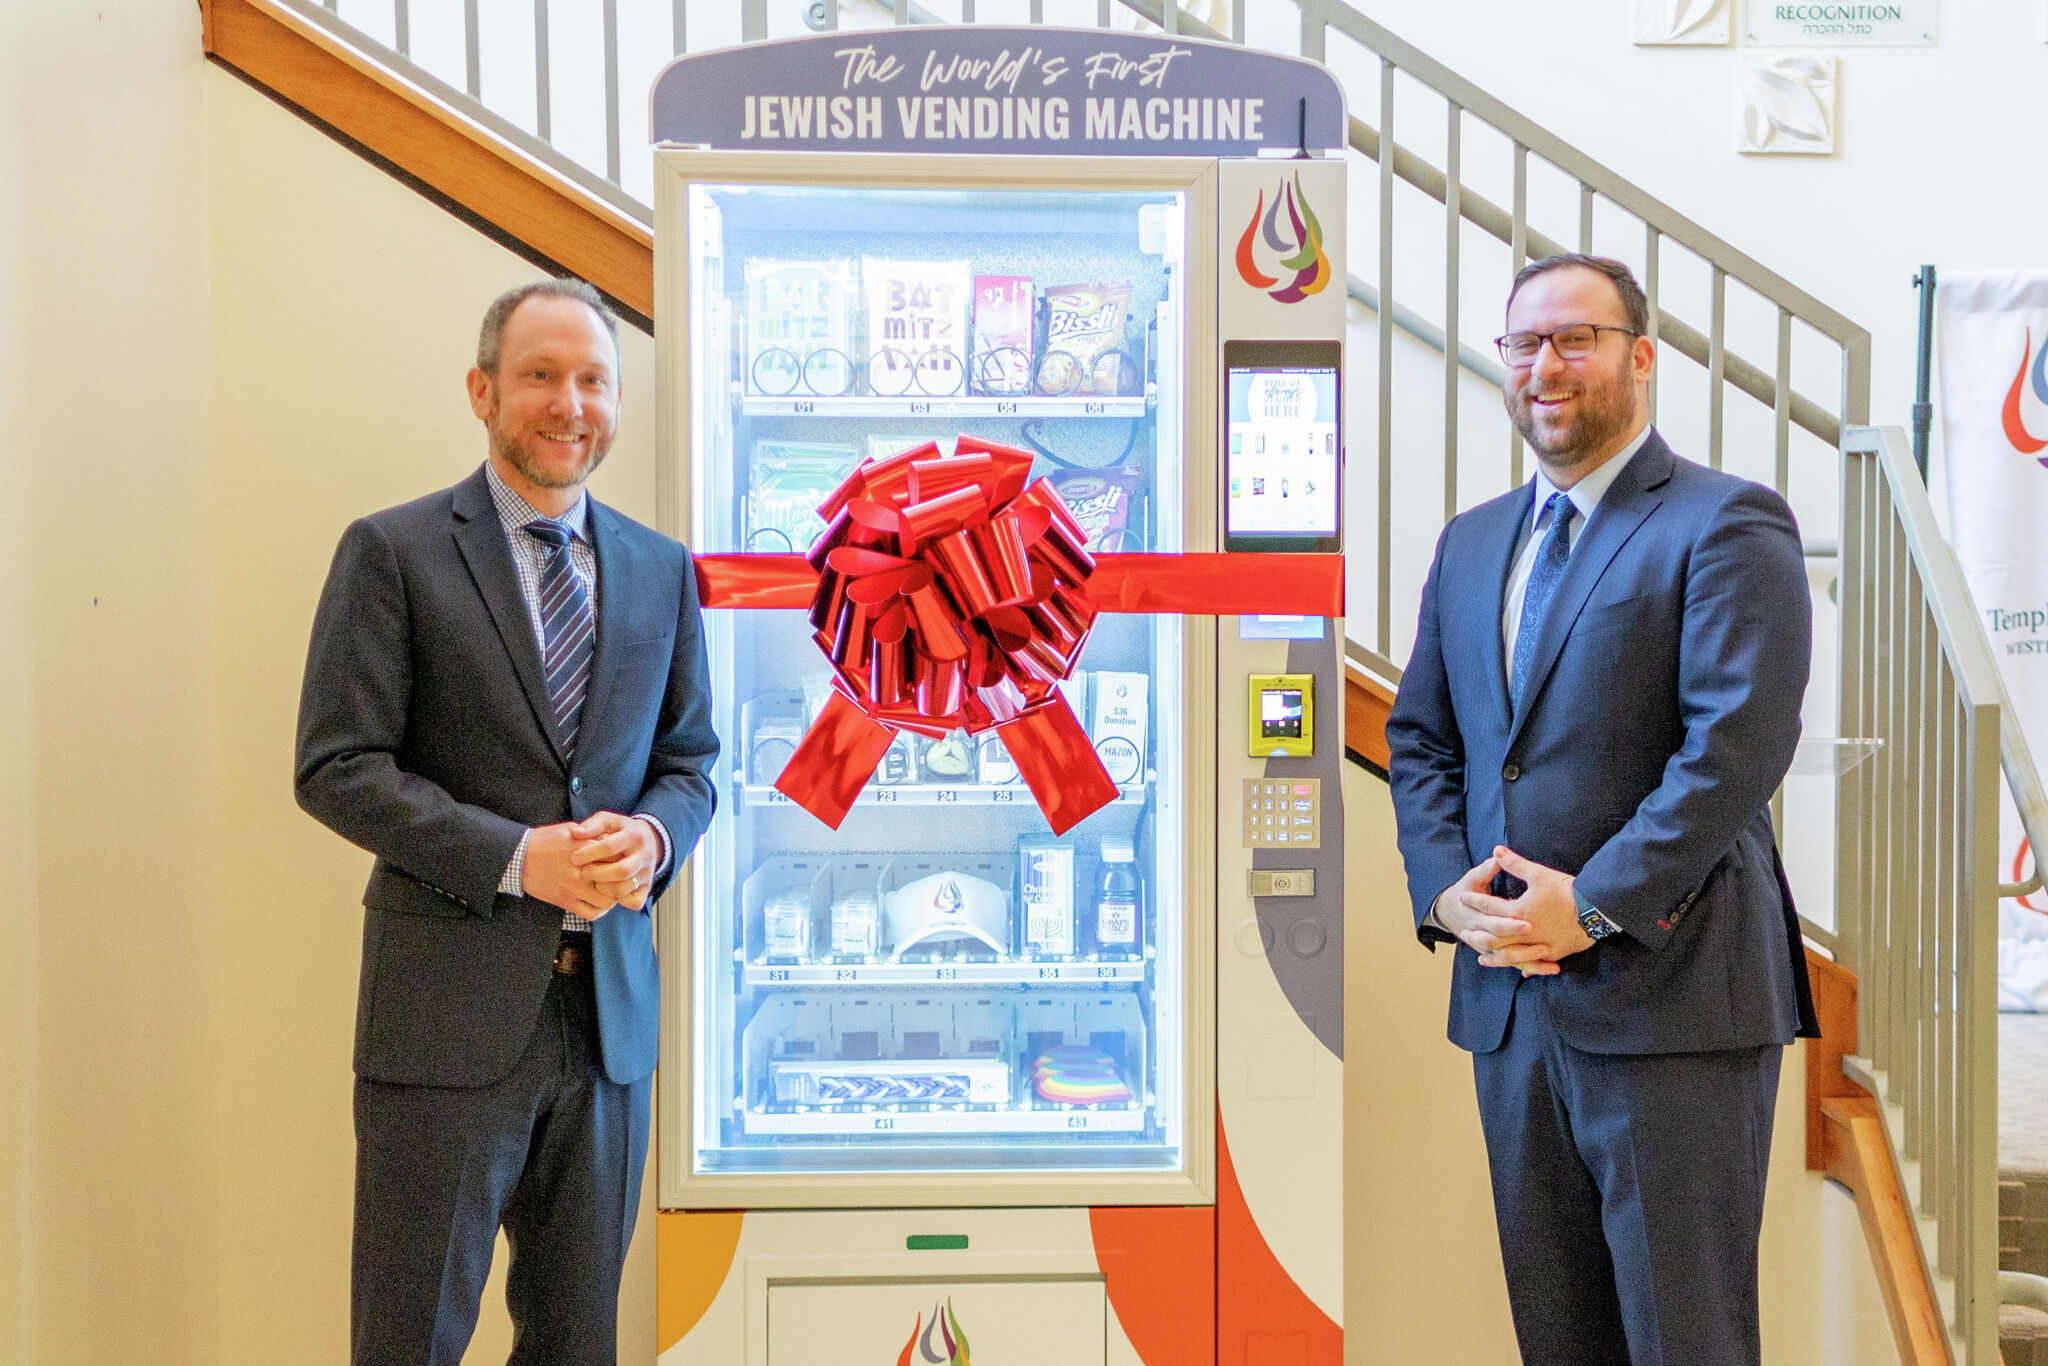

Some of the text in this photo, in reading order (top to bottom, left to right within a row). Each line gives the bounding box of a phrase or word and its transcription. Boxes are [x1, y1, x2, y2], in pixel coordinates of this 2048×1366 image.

[1776, 5, 1901, 20] RECOGNITION
[835, 44, 1192, 94] The World's First
[740, 96, 1264, 141] JEWISH VENDING MACHINE
[1048, 304, 1117, 337] Bissli
[798, 403, 811, 412] 01
[913, 403, 926, 412] 03
[1000, 403, 1014, 412] 05
[1264, 405, 1302, 418] HERE
[1986, 602, 2048, 633] Temp
[2006, 640, 2048, 655] WEST
[1104, 715, 1137, 725] Donation
[1104, 747, 1133, 757] MAZON
[1266, 785, 1272, 795] 2
[1280, 785, 1286, 795] 3
[879, 791, 893, 801] 23
[940, 791, 954, 801] 24
[996, 791, 1010, 801] 25
[1266, 832, 1272, 842] 0
[771, 971, 785, 980] 31
[839, 971, 854, 980] 32
[939, 970, 954, 980] 33
[1041, 969, 1056, 978] 35
[877, 1118, 890, 1129] 41
[1069, 1117, 1083, 1127] 43
